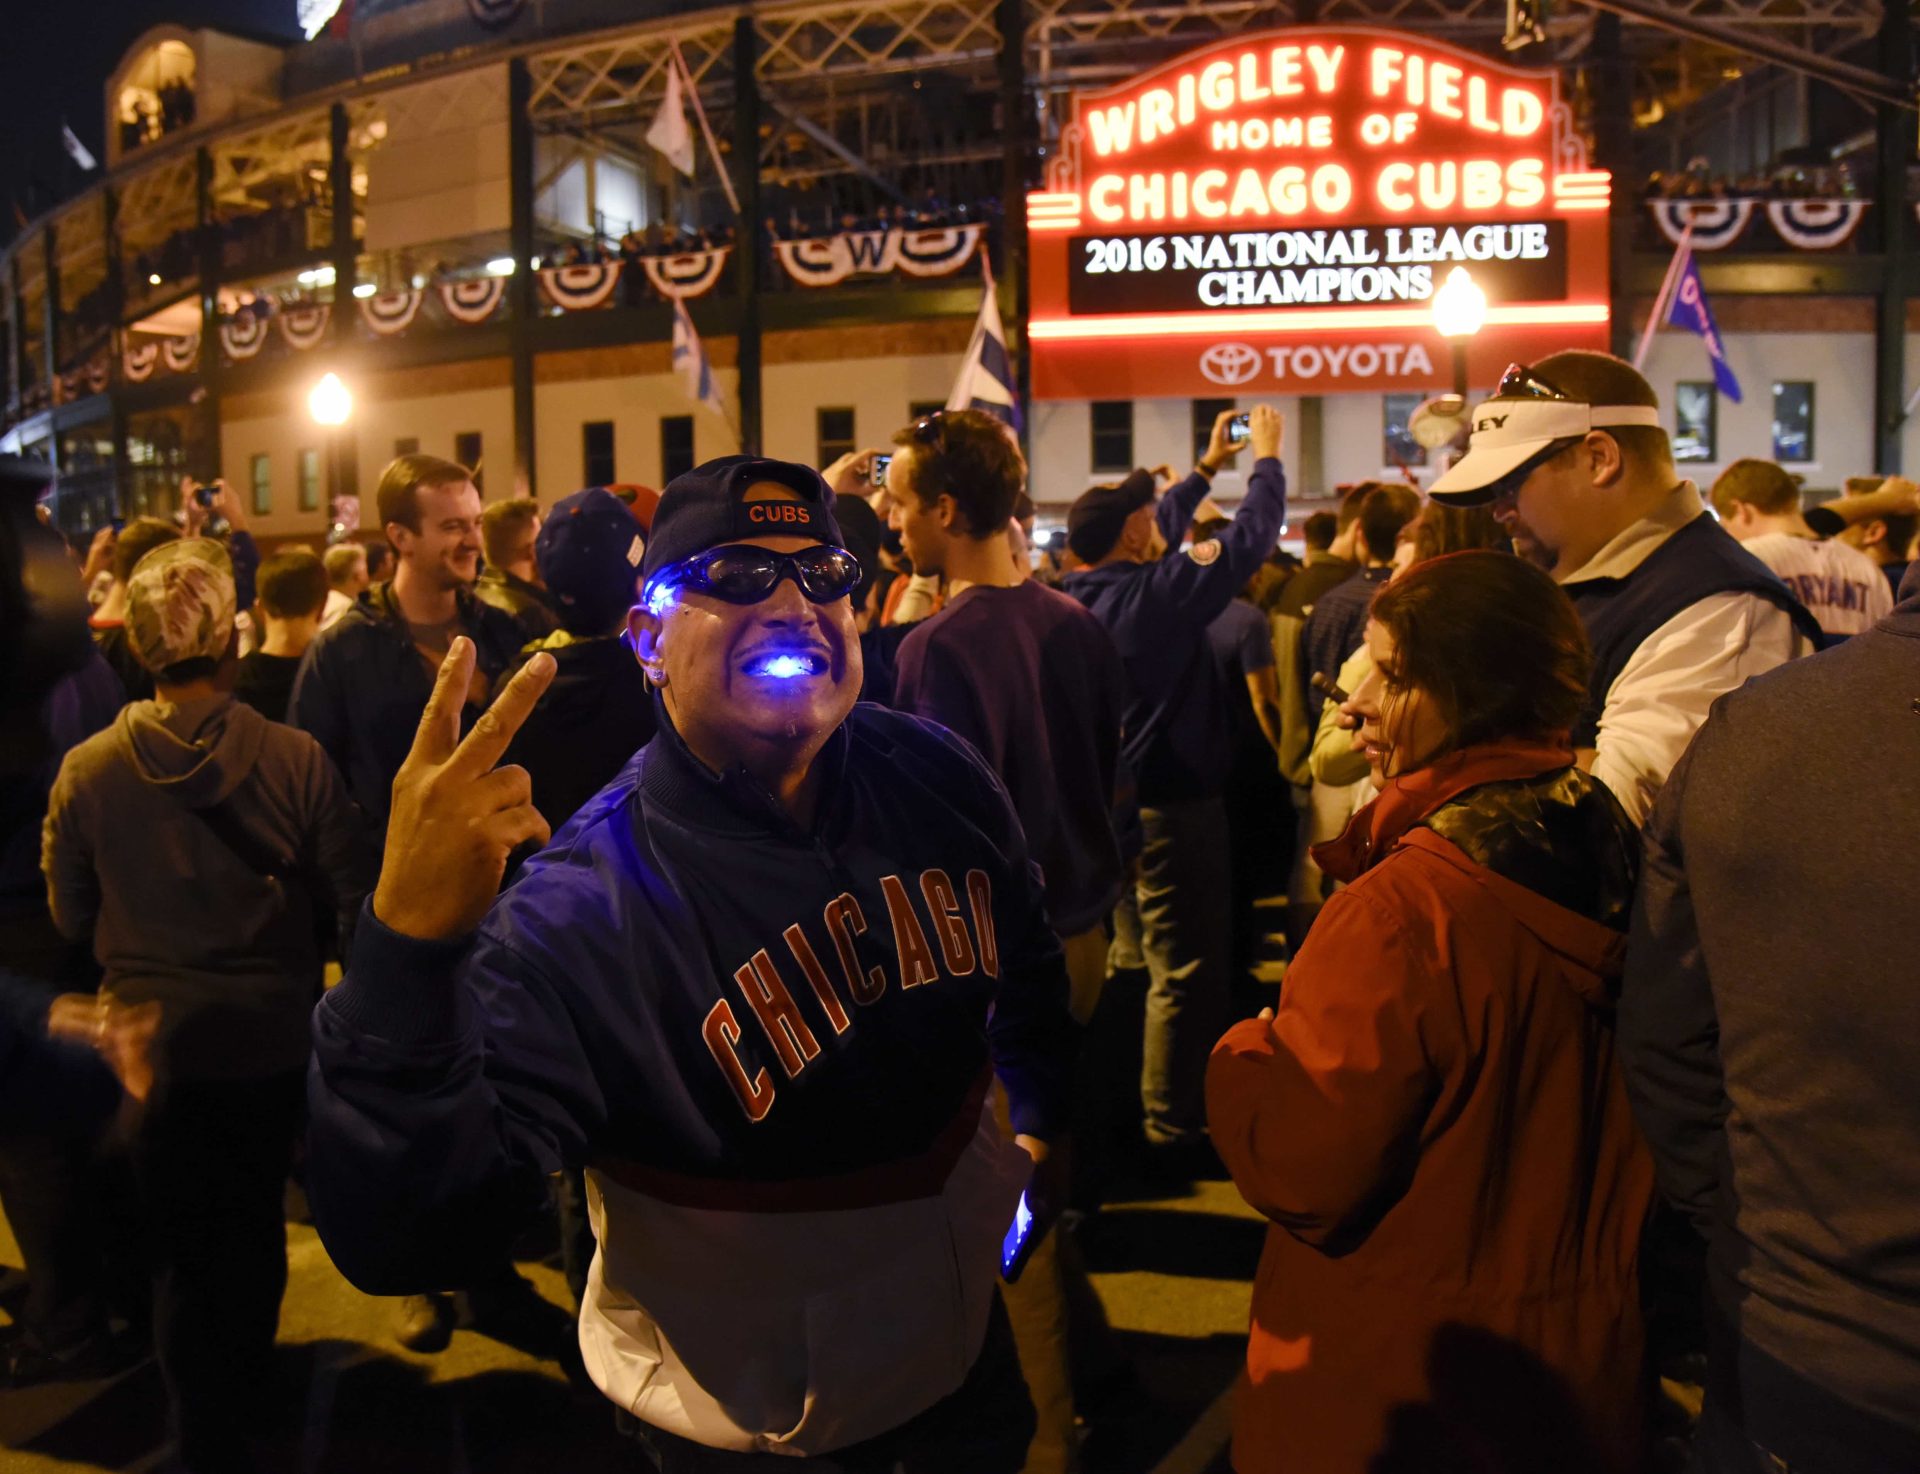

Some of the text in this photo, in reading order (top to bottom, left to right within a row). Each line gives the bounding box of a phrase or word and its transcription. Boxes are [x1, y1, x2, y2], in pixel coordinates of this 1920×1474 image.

[1089, 45, 1543, 156] WRIGLEY FIELD
[1212, 112, 1418, 150] HOME OF
[1089, 159, 1546, 221] CHICAGO CUBS
[845, 230, 888, 267] W
[1085, 224, 1548, 273] 2016 NATIONAL LEAGUE
[1199, 266, 1433, 305] CHAMPIONS
[1267, 344, 1433, 377] TOYOTA
[1472, 414, 1509, 433] EY
[749, 505, 810, 523] CUBS
[702, 868, 999, 1122] CHICAGO
